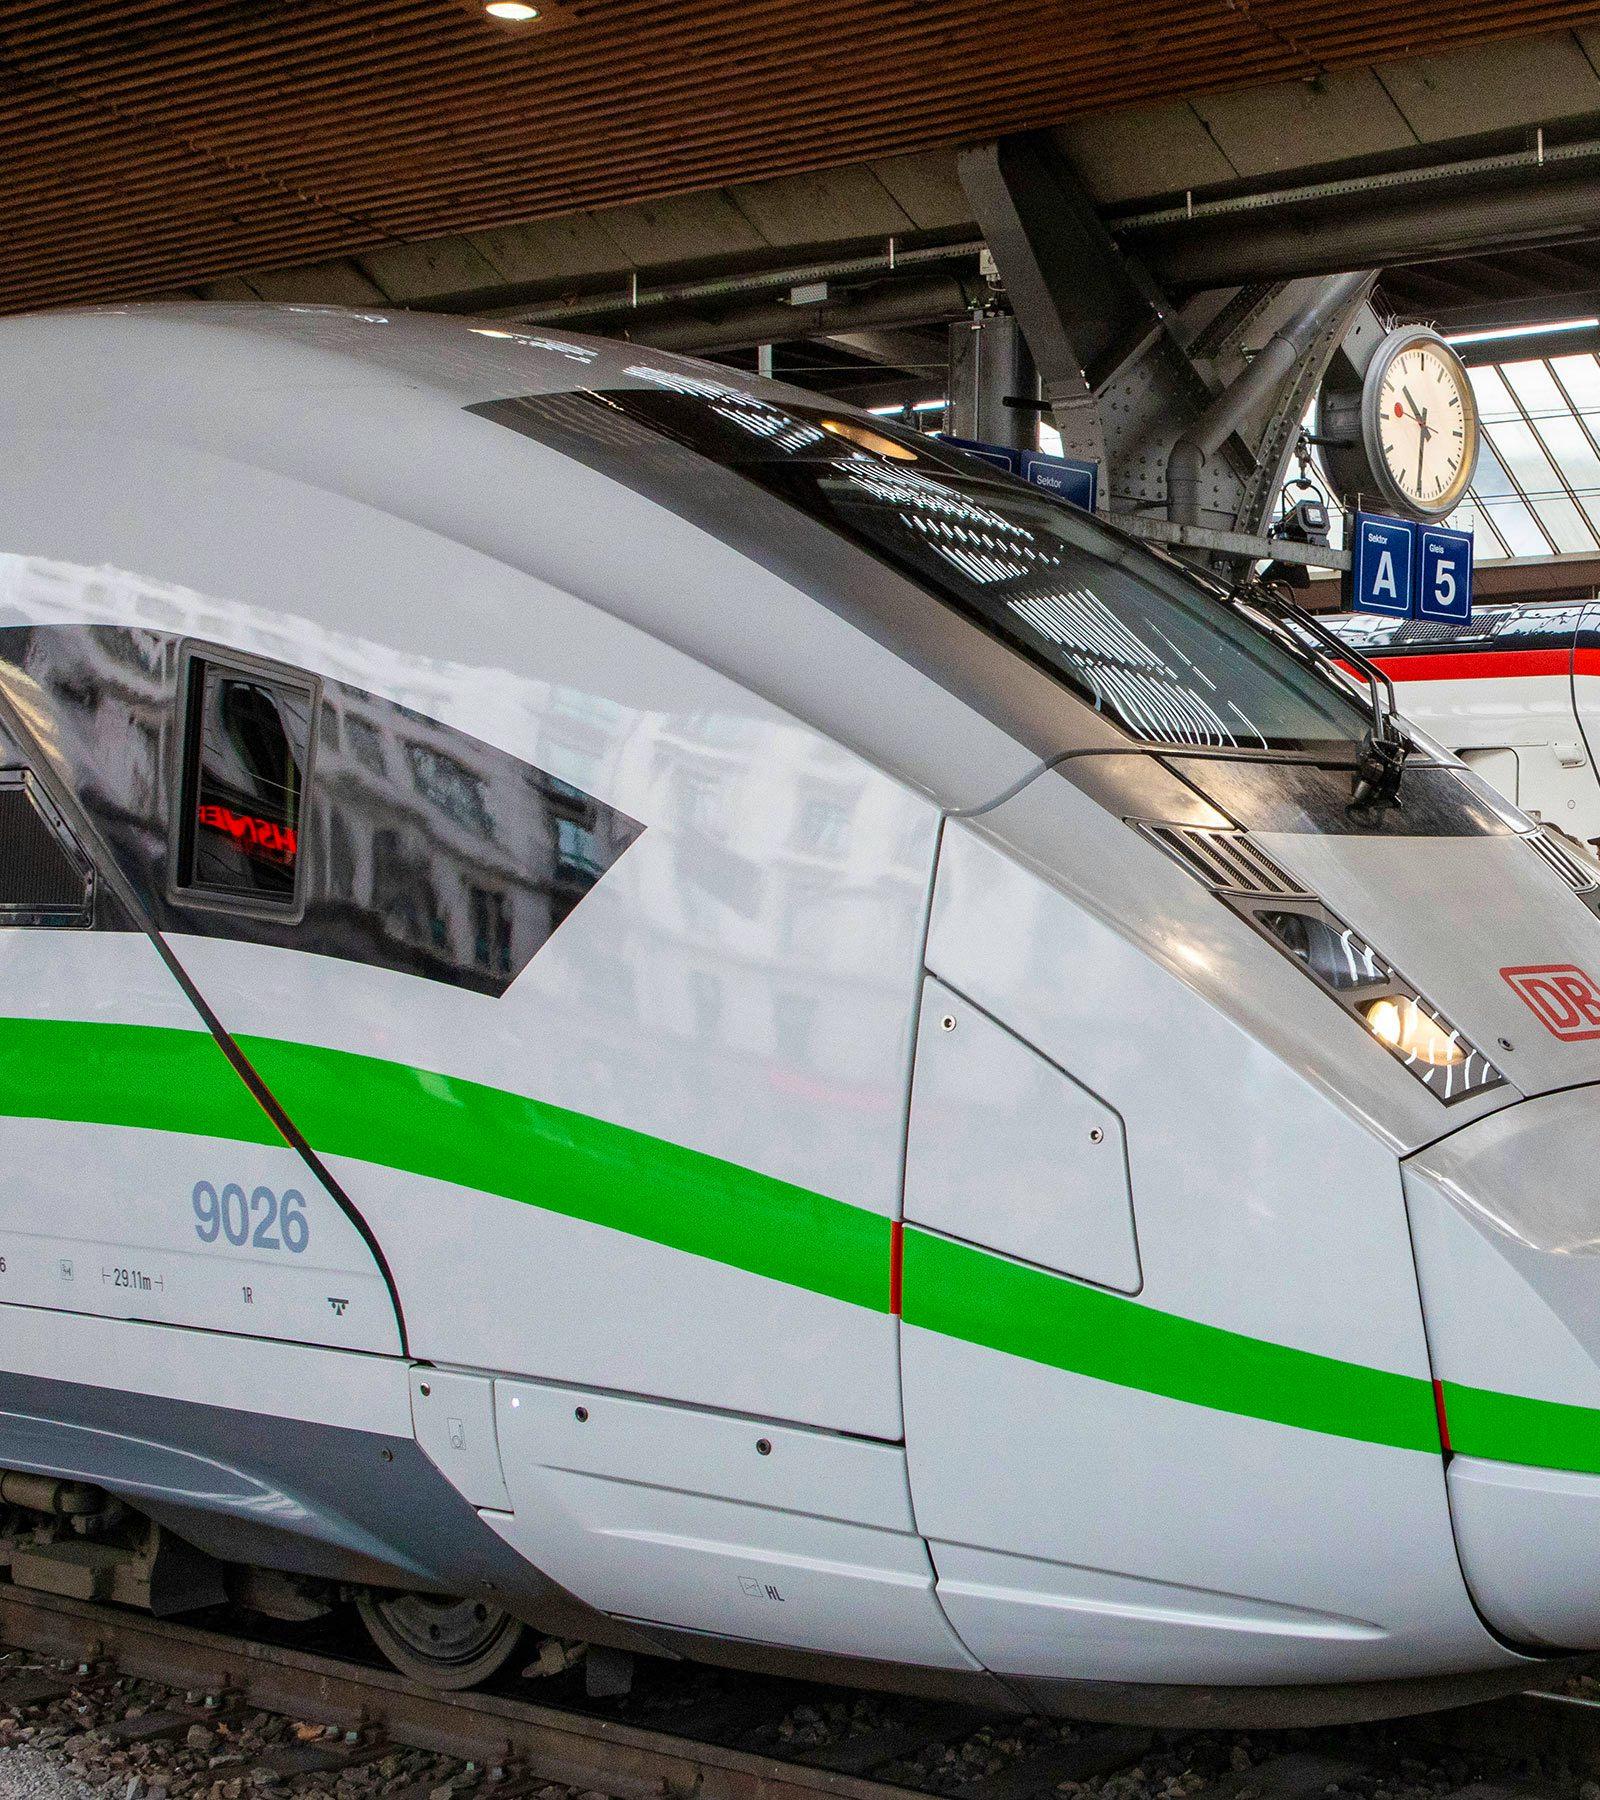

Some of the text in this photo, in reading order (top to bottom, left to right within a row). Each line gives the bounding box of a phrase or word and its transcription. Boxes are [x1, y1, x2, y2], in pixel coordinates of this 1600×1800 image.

[1036, 474, 1062, 489] Sektor
[1367, 533, 1388, 545] Sektor
[1429, 543, 1445, 555] Gleis
[1372, 550, 1397, 599] A
[1434, 559, 1456, 606] 5
[191, 1180, 310, 1254] 9026
[764, 1584, 786, 1602] HL
